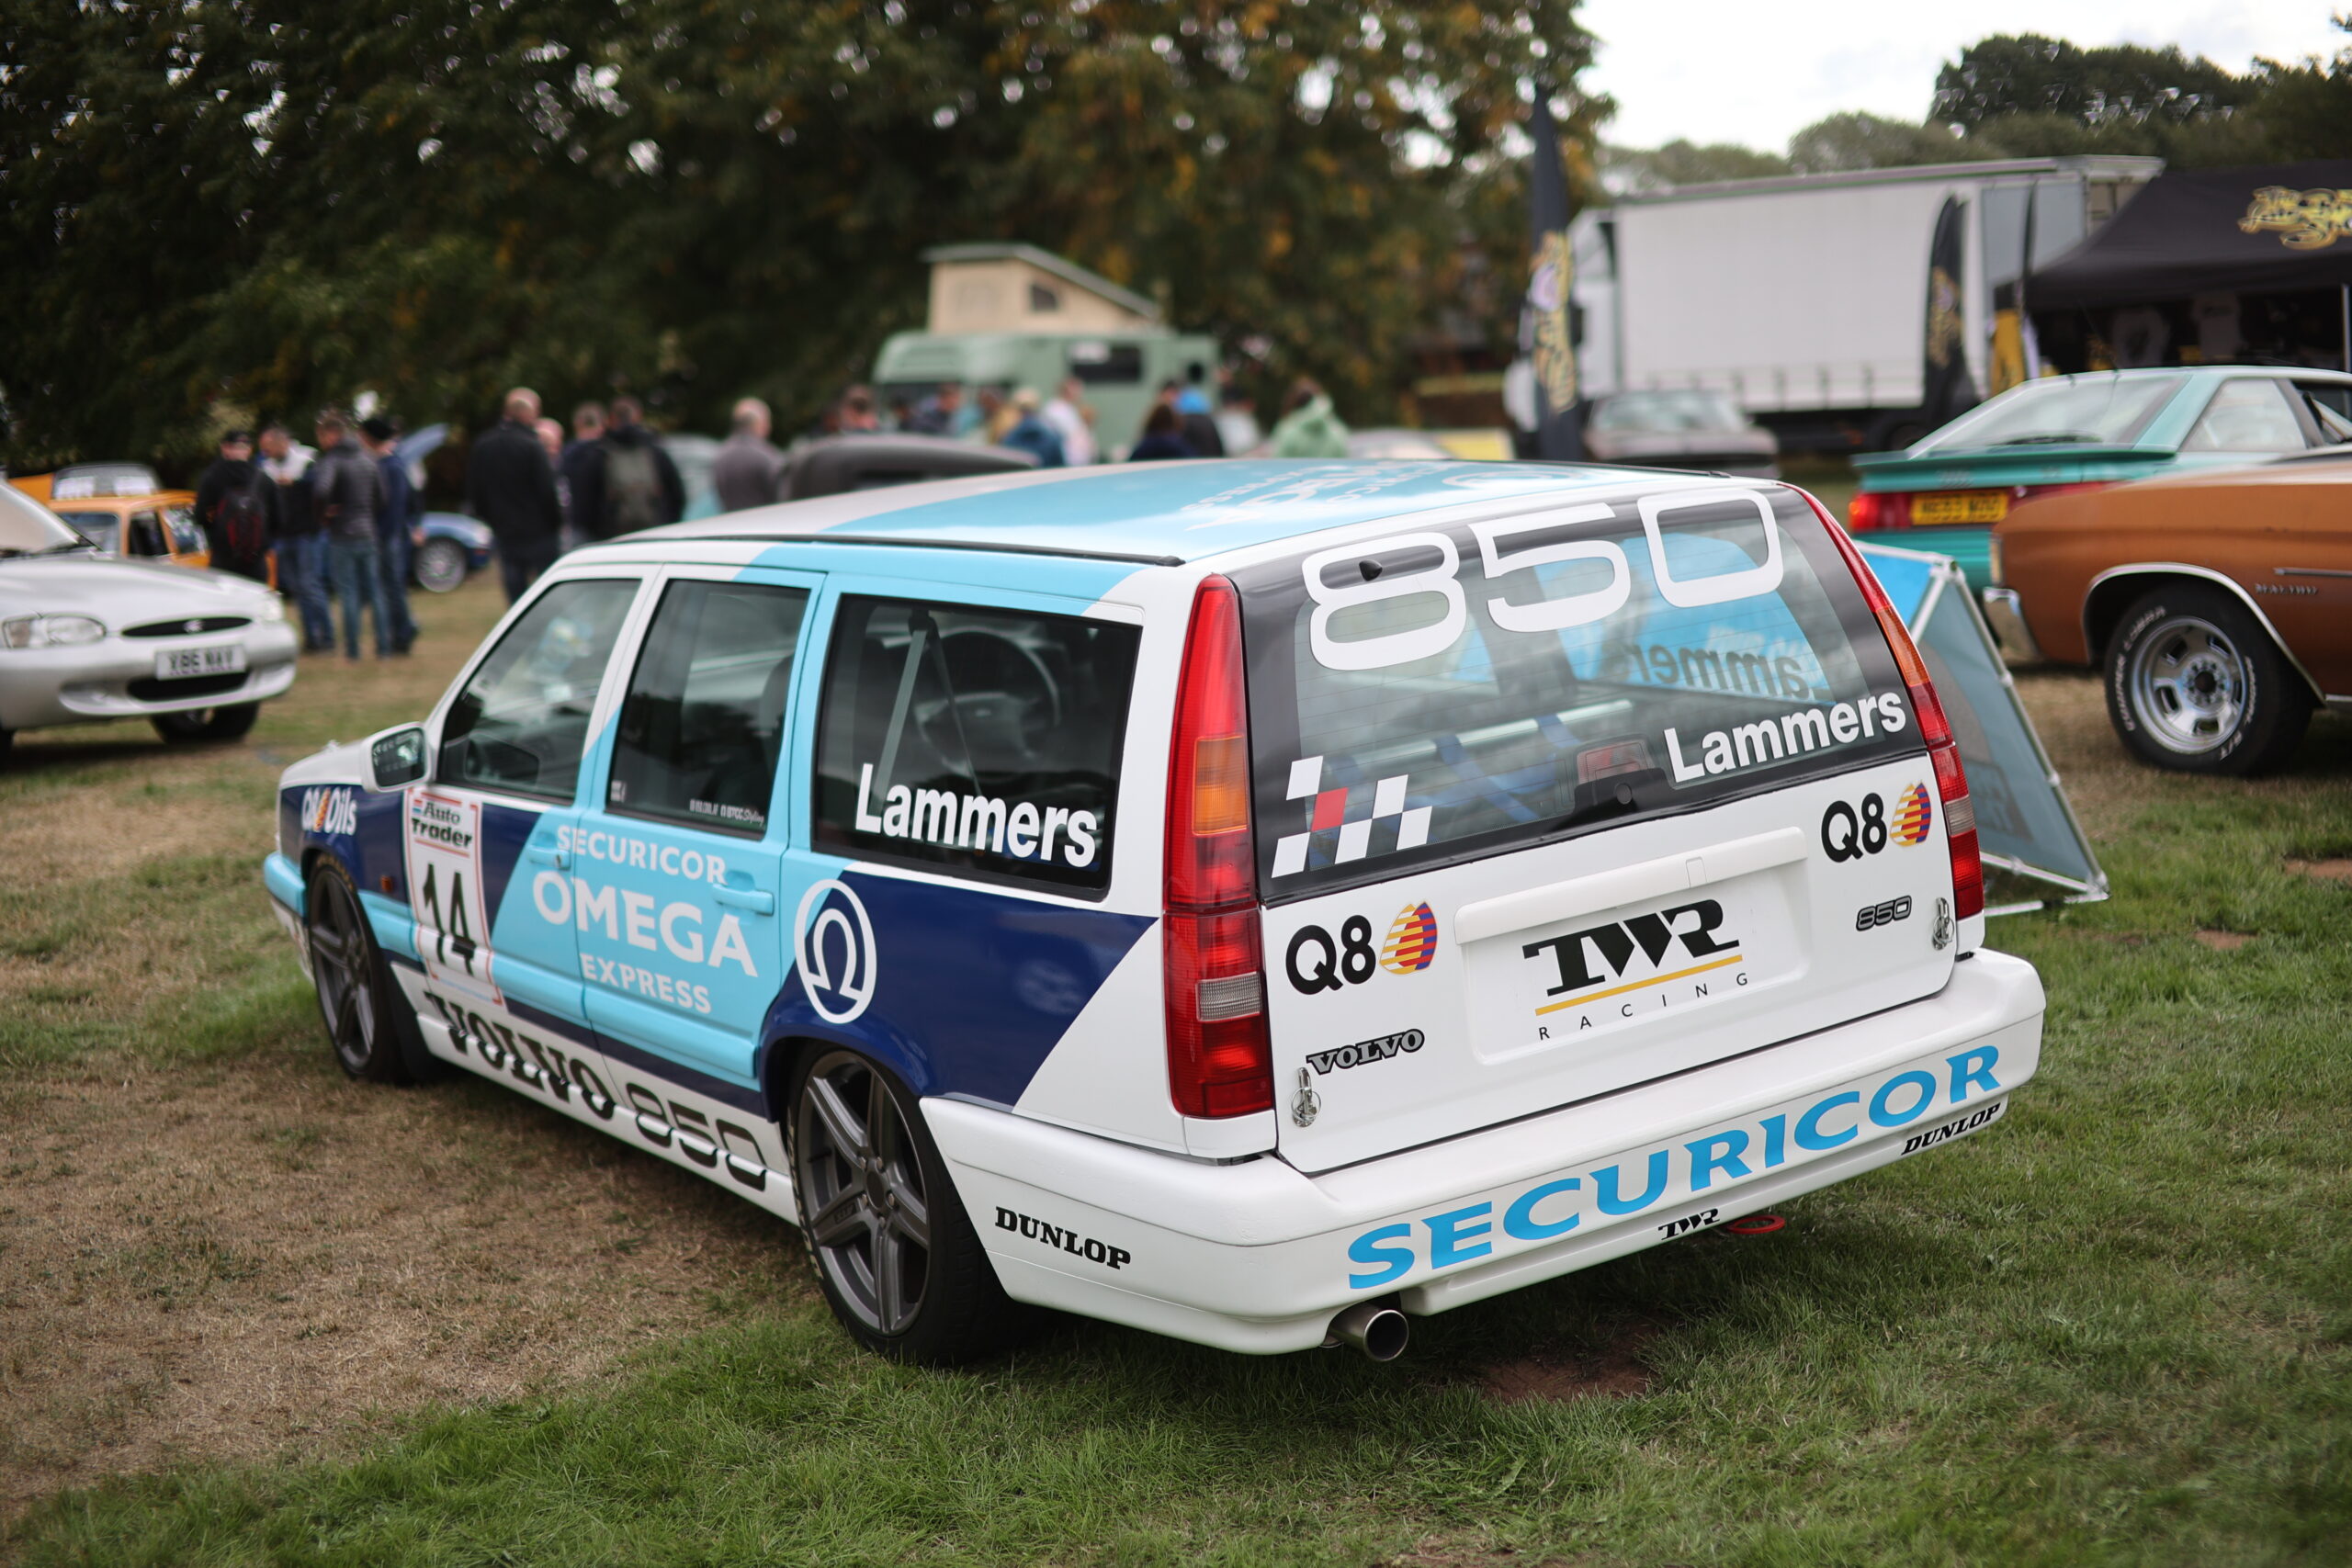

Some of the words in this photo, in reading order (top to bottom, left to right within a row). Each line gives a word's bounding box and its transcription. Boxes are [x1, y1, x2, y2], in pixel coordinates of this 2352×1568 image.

[1302, 488, 1783, 671] 850
[1664, 691, 1906, 783] Lammers
[324, 786, 356, 835] Oils
[412, 818, 472, 849] Trader
[423, 801, 461, 823] Auto
[854, 763, 1097, 868] Lammers
[1821, 793, 1886, 863] Q8
[557, 825, 729, 886] SECURICOR
[424, 863, 477, 976] 14
[533, 870, 759, 978] OMEGA
[1522, 898, 1740, 997] TWR
[1856, 895, 1912, 931] 850
[580, 952, 712, 1015] EXPRESS
[1285, 914, 1376, 995] Q8
[1538, 972, 1748, 1041] RACING
[1306, 1028, 1426, 1076] VOLVO
[424, 990, 615, 1121] VOLVO
[626, 1082, 767, 1192] 850
[1900, 1102, 2001, 1156] DUNLOP
[1348, 1044, 2002, 1290] SECURICOR
[994, 1206, 1132, 1270] DUNLOP
[1657, 1208, 1721, 1241] TWR
